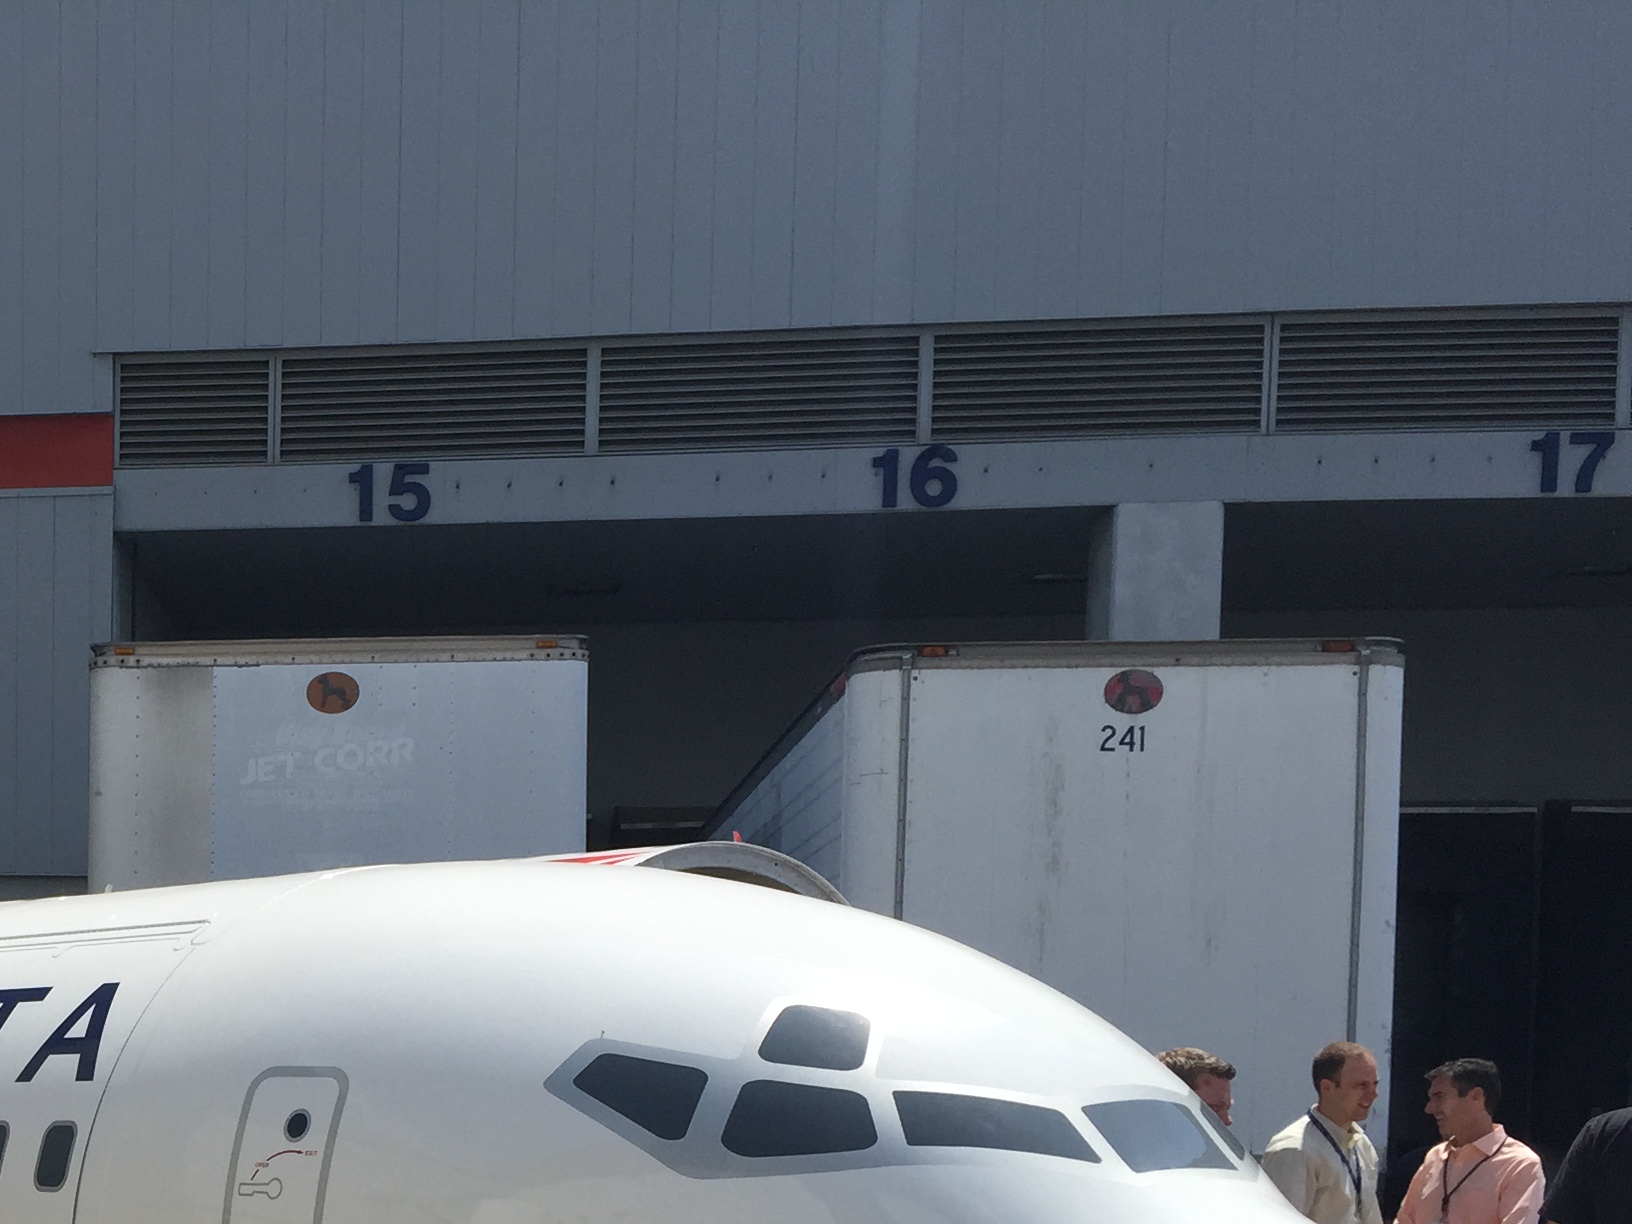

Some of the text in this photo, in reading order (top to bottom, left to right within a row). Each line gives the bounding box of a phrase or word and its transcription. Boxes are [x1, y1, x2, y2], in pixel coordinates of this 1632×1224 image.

[348, 462, 432, 523] 15
[872, 444, 959, 508] 16
[1530, 430, 1615, 493] 17
[1099, 725, 1147, 753] 241
